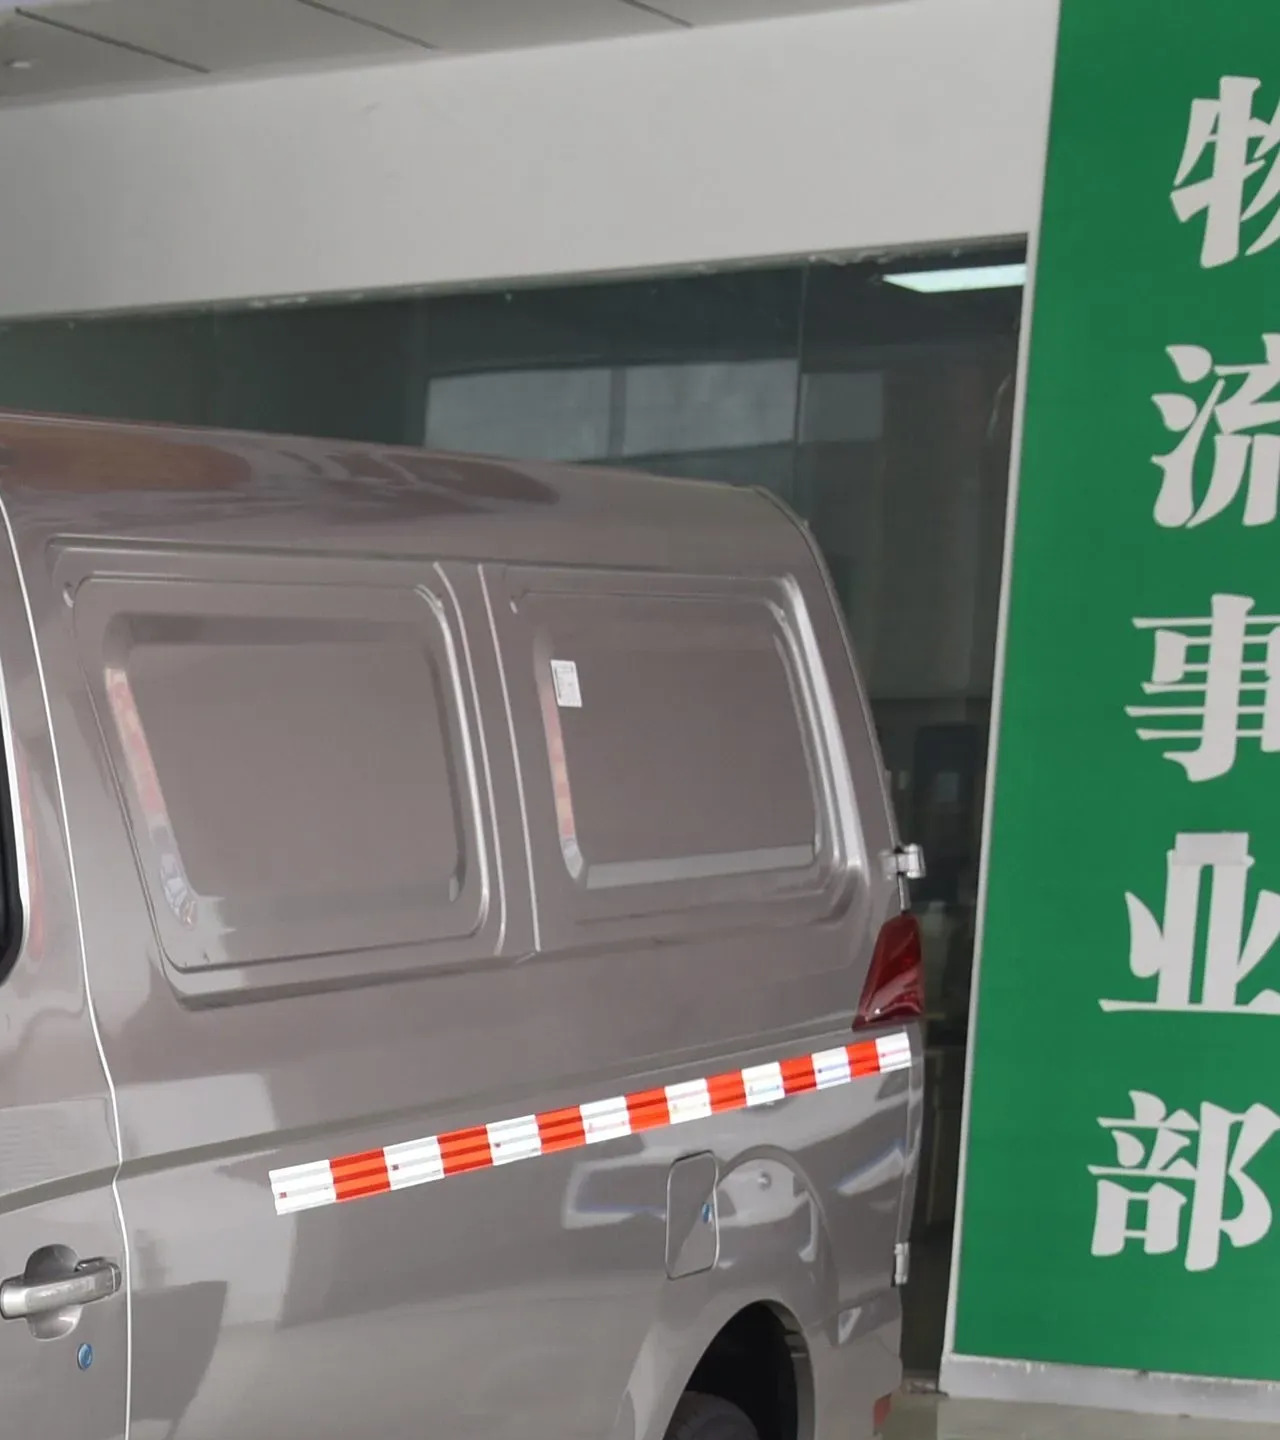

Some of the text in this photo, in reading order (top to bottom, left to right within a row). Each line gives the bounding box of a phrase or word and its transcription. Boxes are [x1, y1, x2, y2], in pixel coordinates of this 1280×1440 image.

[1087, 75, 1280, 1272] 物流事业部
